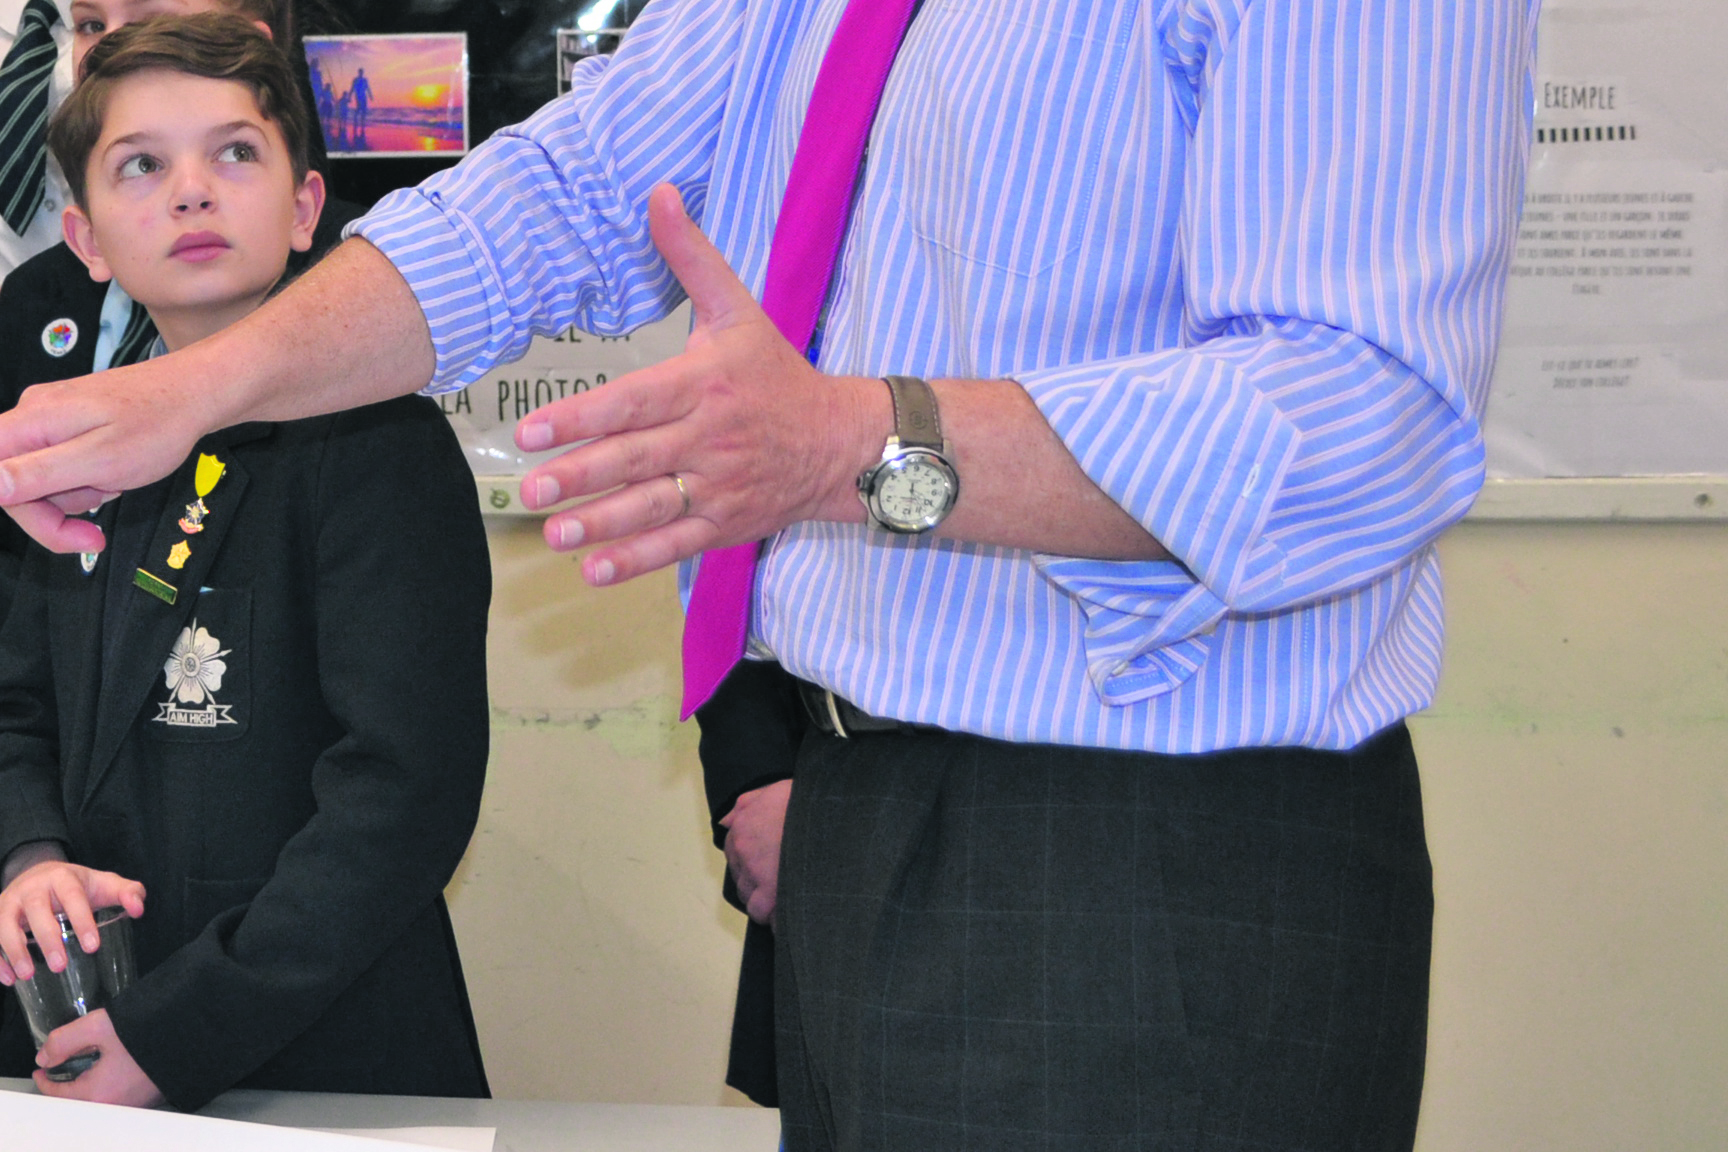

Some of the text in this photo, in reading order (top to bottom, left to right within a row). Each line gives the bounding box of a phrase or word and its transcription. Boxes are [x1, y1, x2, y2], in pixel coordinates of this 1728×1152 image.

[1544, 81, 1616, 110] EXEMPLE
[169, 711, 213, 724] AIM HIGH
